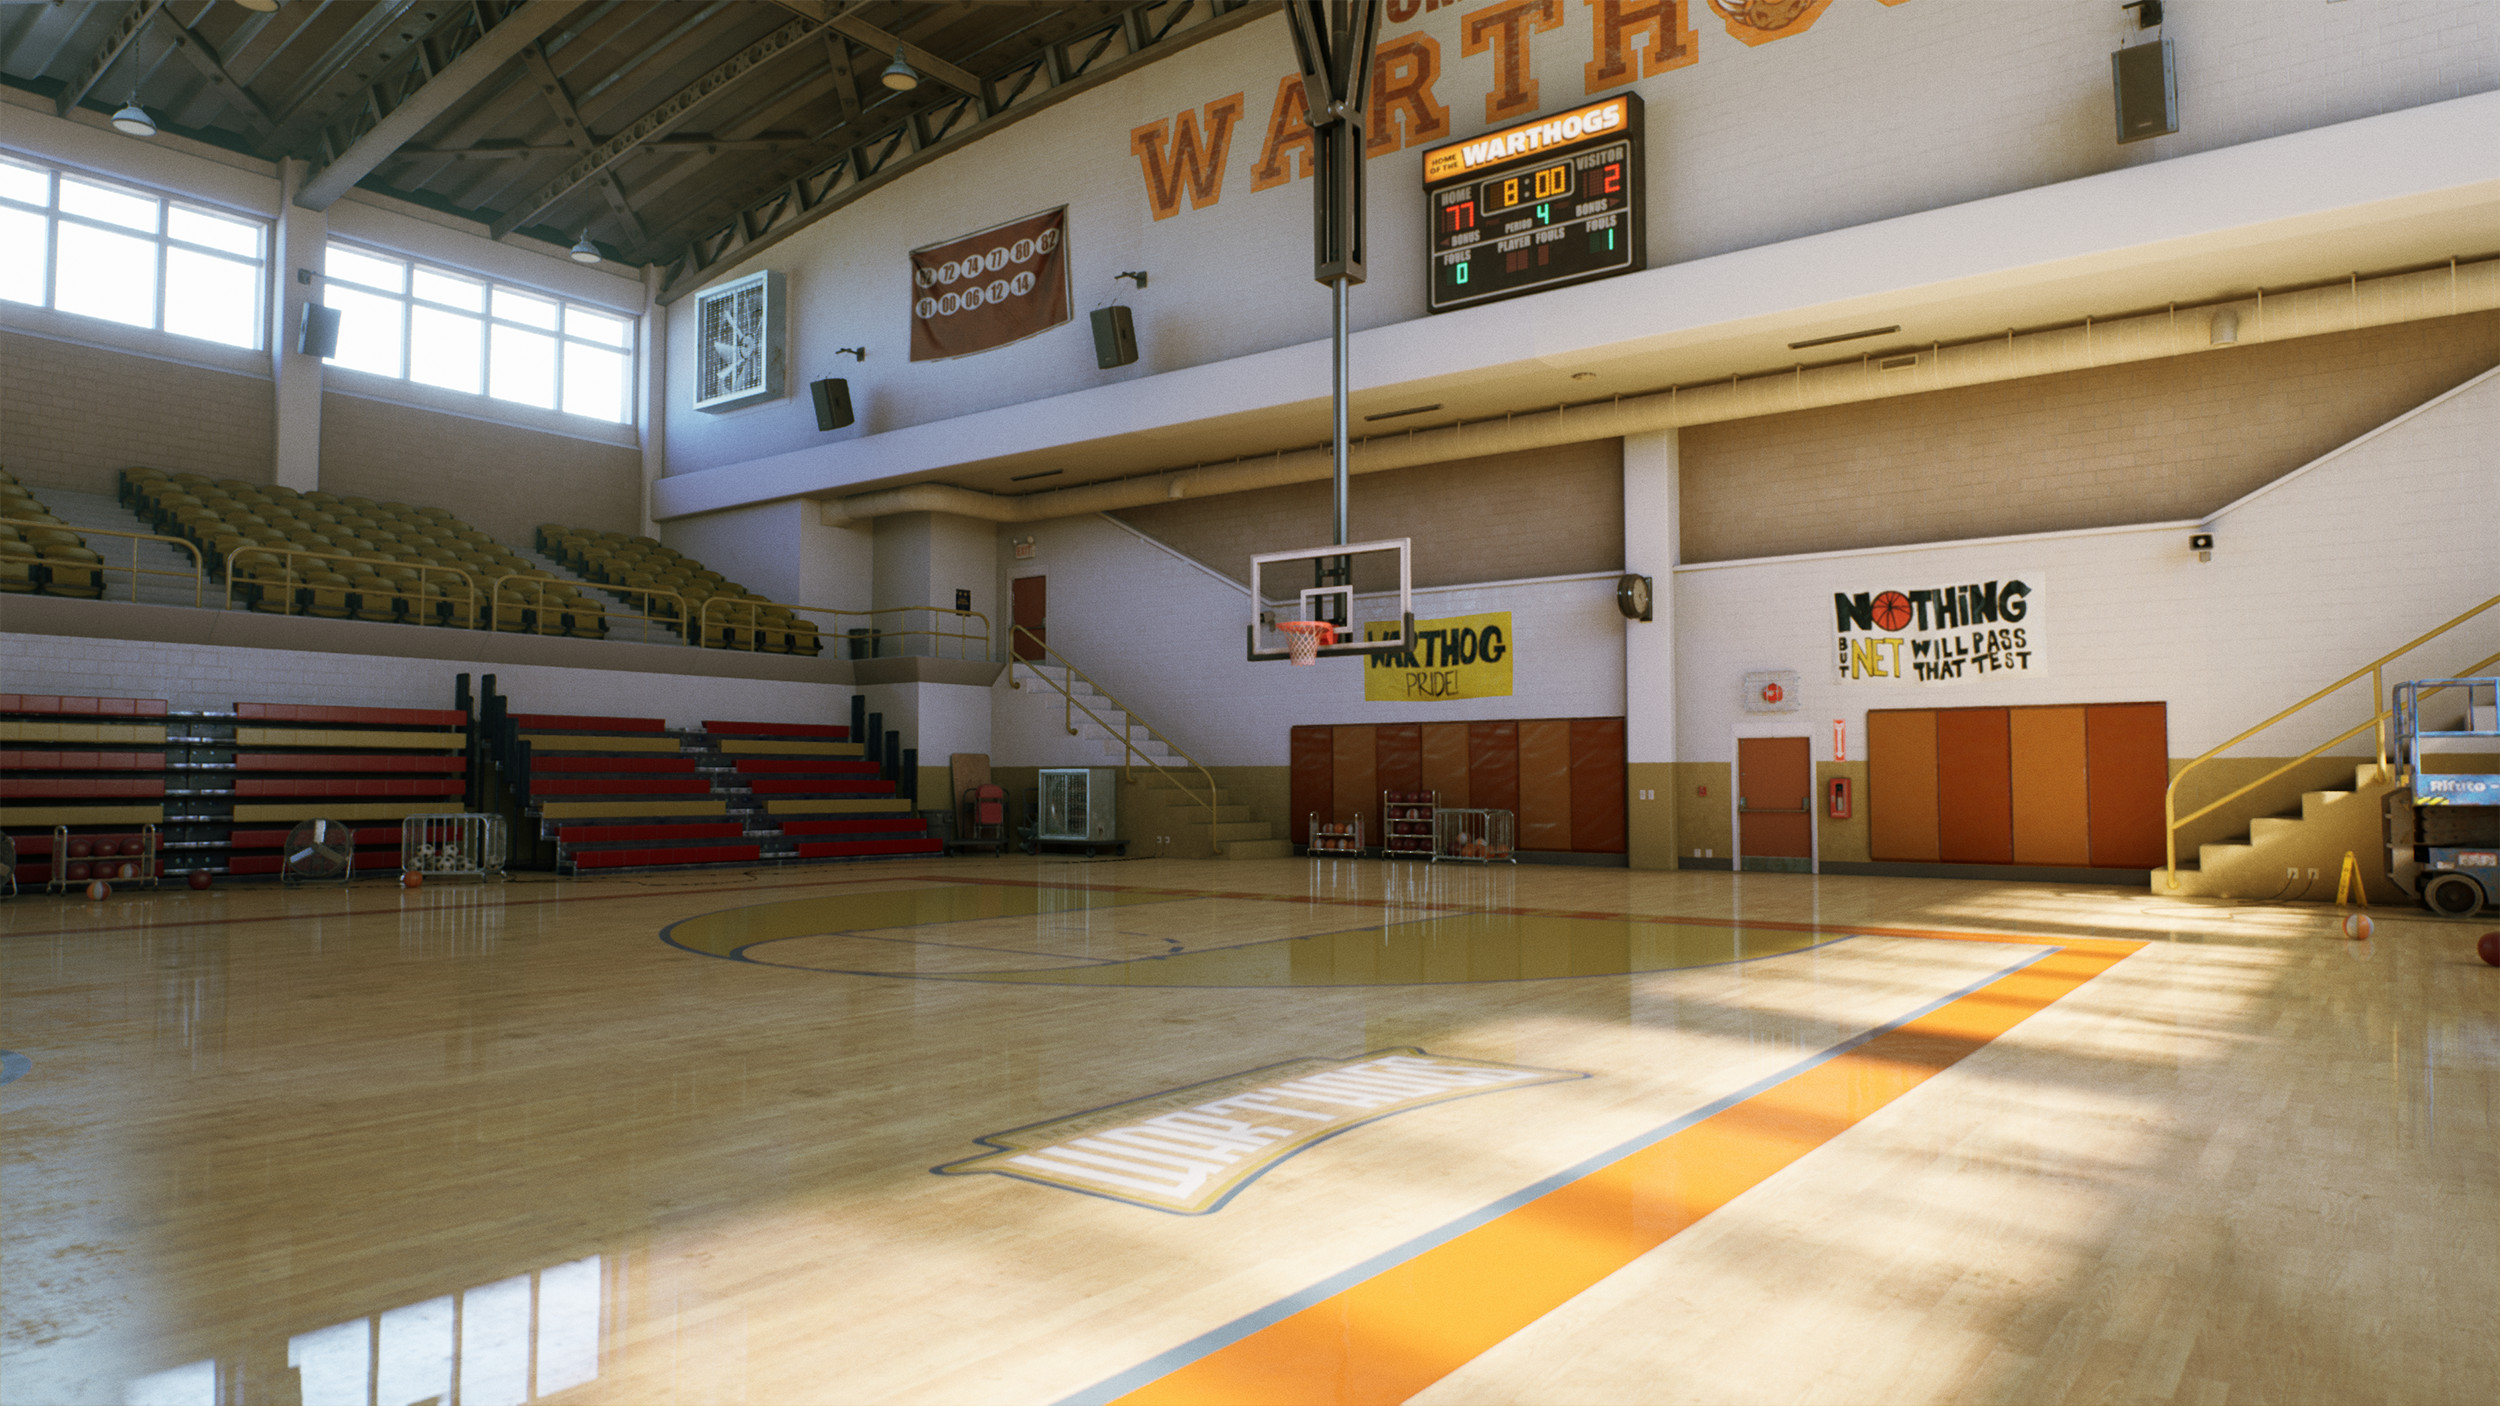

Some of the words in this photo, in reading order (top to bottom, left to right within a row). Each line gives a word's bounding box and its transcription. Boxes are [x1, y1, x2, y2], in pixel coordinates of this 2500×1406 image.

[1462, 104, 1620, 168] WARTHOGS
[1432, 153, 1457, 166] HOME
[1442, 161, 1459, 172] THE
[1576, 147, 1624, 170] VISITOR
[1504, 165, 1566, 207] 8:00
[1604, 163, 1620, 194] 2
[1441, 186, 1472, 206] HOME
[1575, 198, 1608, 217] BONUS
[1446, 201, 1474, 231] 77
[1536, 203, 1549, 225] 4
[1585, 215, 1617, 232] FOULS
[1504, 218, 1532, 234] PERIOD
[1451, 230, 1480, 247] BONUS
[1497, 235, 1531, 253] PLAYER
[1535, 227, 1565, 244] FOULS
[1608, 228, 1614, 250] 1
[943, 266, 956, 281] 72
[967, 259, 979, 276] 74
[990, 251, 1003, 268] 77
[1041, 231, 1056, 251] 82
[1443, 249, 1471, 266] FOULS
[1456, 262, 1468, 285] 0
[965, 289, 979, 307] 06
[991, 282, 1004, 299] 12
[1016, 275, 1029, 294] 14
[1911, 637, 1968, 660] WILL
[1972, 628, 2027, 654] PASS
[1838, 637, 1849, 678] BUT
[1852, 638, 1904, 679] NET
[1913, 658, 1966, 682] THAT
[1971, 651, 2032, 674] TEST
